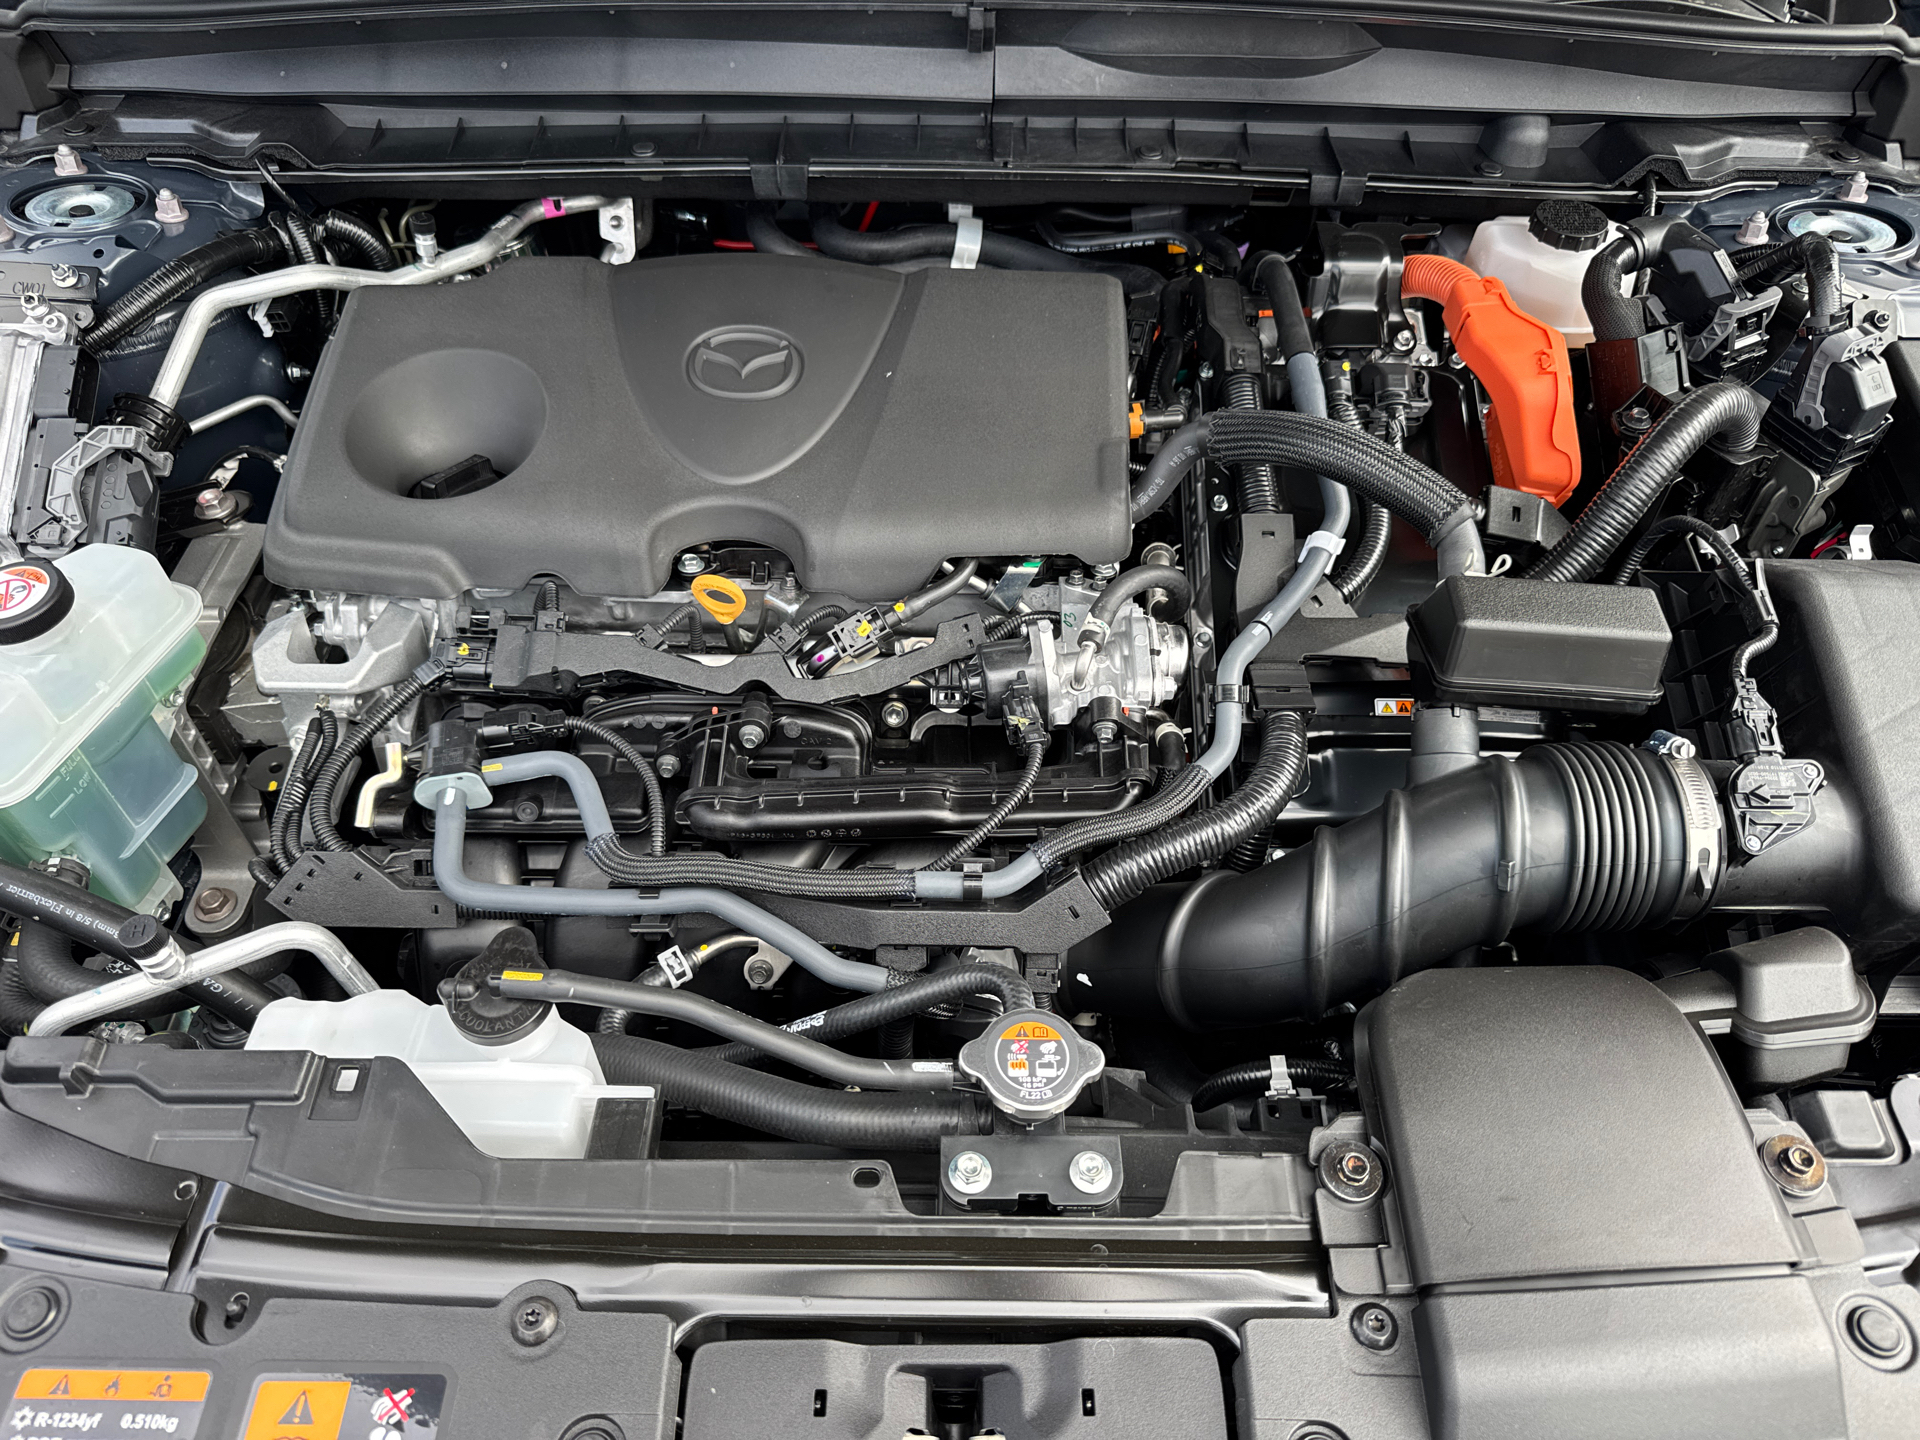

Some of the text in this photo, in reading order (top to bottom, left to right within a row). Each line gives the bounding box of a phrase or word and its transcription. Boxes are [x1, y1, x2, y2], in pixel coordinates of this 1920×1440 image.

[59, 754, 81, 778] FULL
[73, 771, 91, 795] LOW
[5, 883, 66, 916] Flexbarrier
[33, 1411, 179, 1434] R-1234yf 0.510kg
